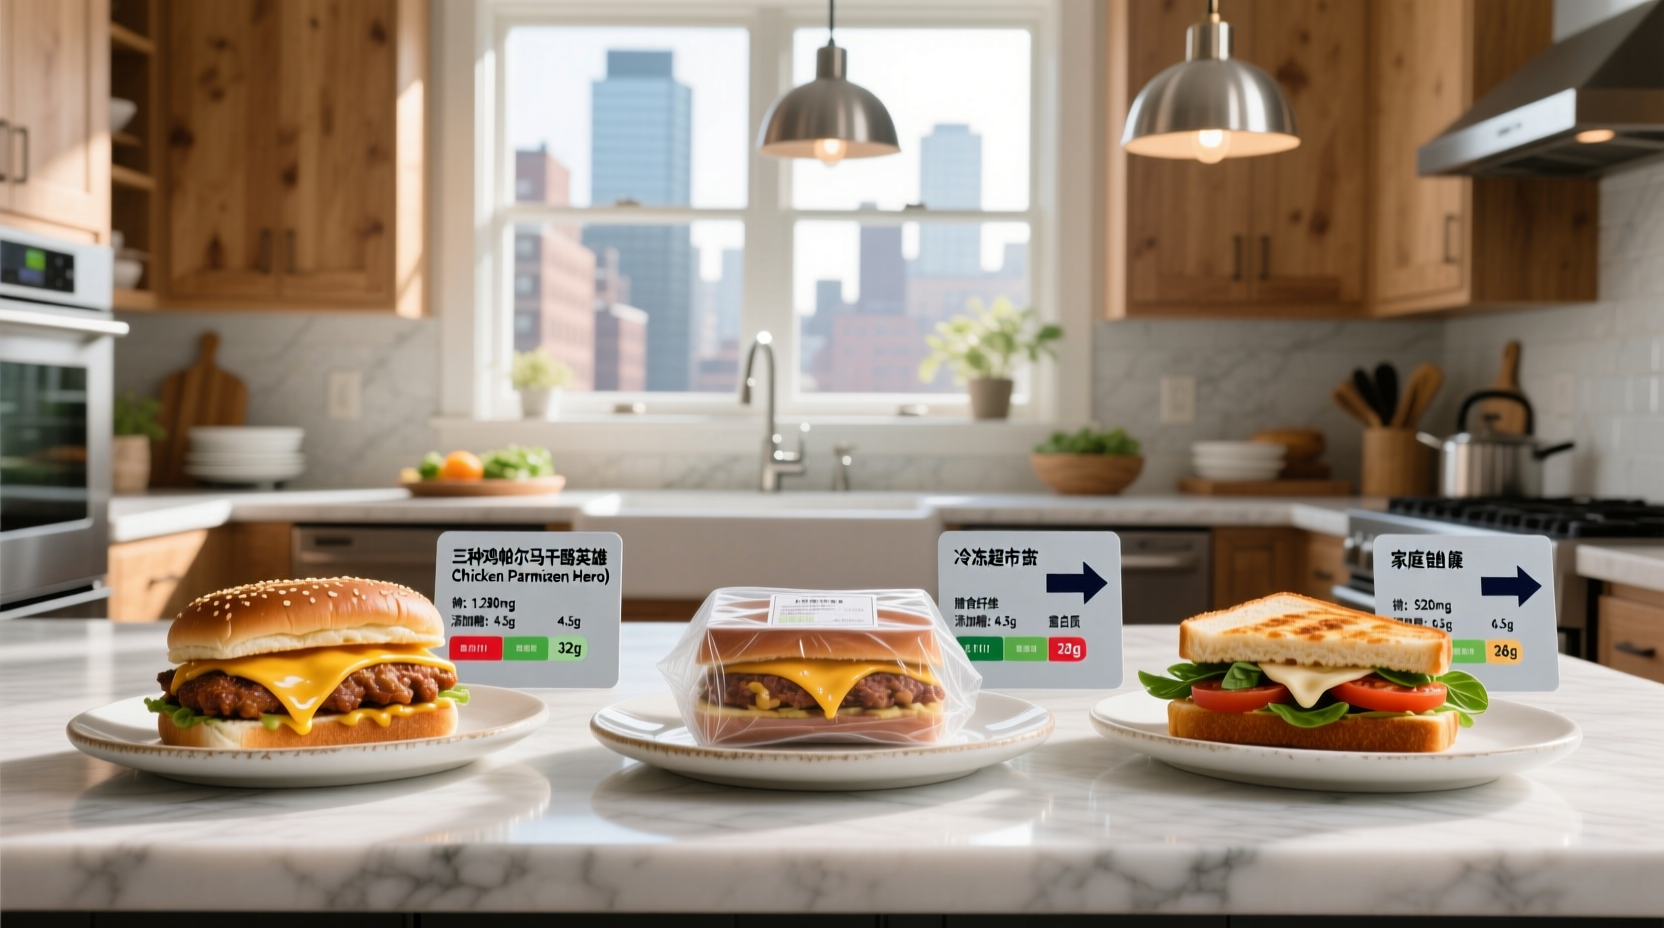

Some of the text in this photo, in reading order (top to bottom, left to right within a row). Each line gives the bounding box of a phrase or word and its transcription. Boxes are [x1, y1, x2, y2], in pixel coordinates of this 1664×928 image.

[452, 568, 504, 583] Chicken
[572, 568, 610, 585] Hero)
[558, 641, 582, 657] 32g
